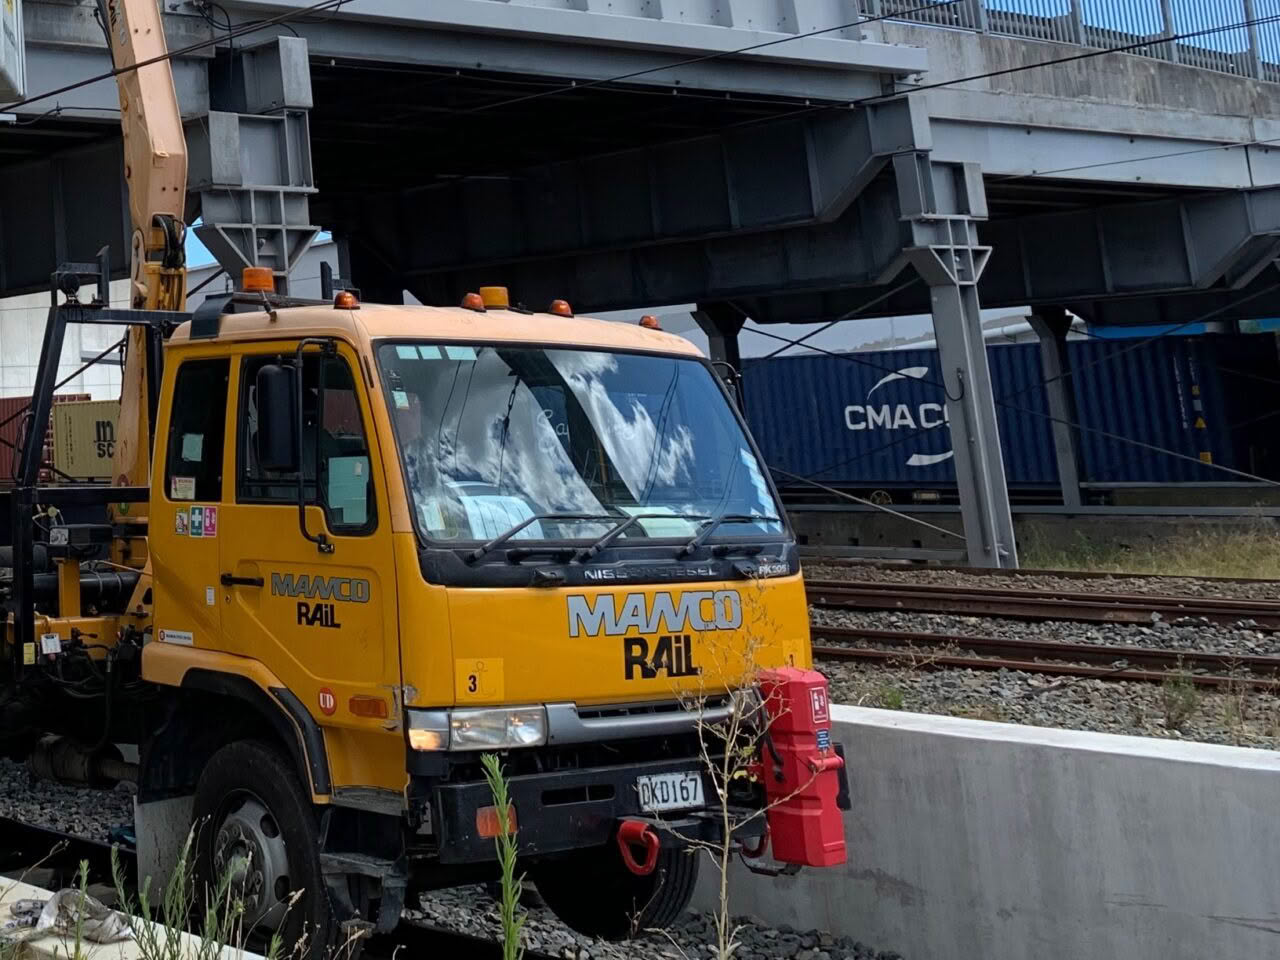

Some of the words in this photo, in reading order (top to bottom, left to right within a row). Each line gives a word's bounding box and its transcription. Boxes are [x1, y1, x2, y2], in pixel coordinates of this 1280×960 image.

[844, 404, 917, 430] CMA
[468, 674, 477, 693] 3
[319, 692, 334, 709] UD
